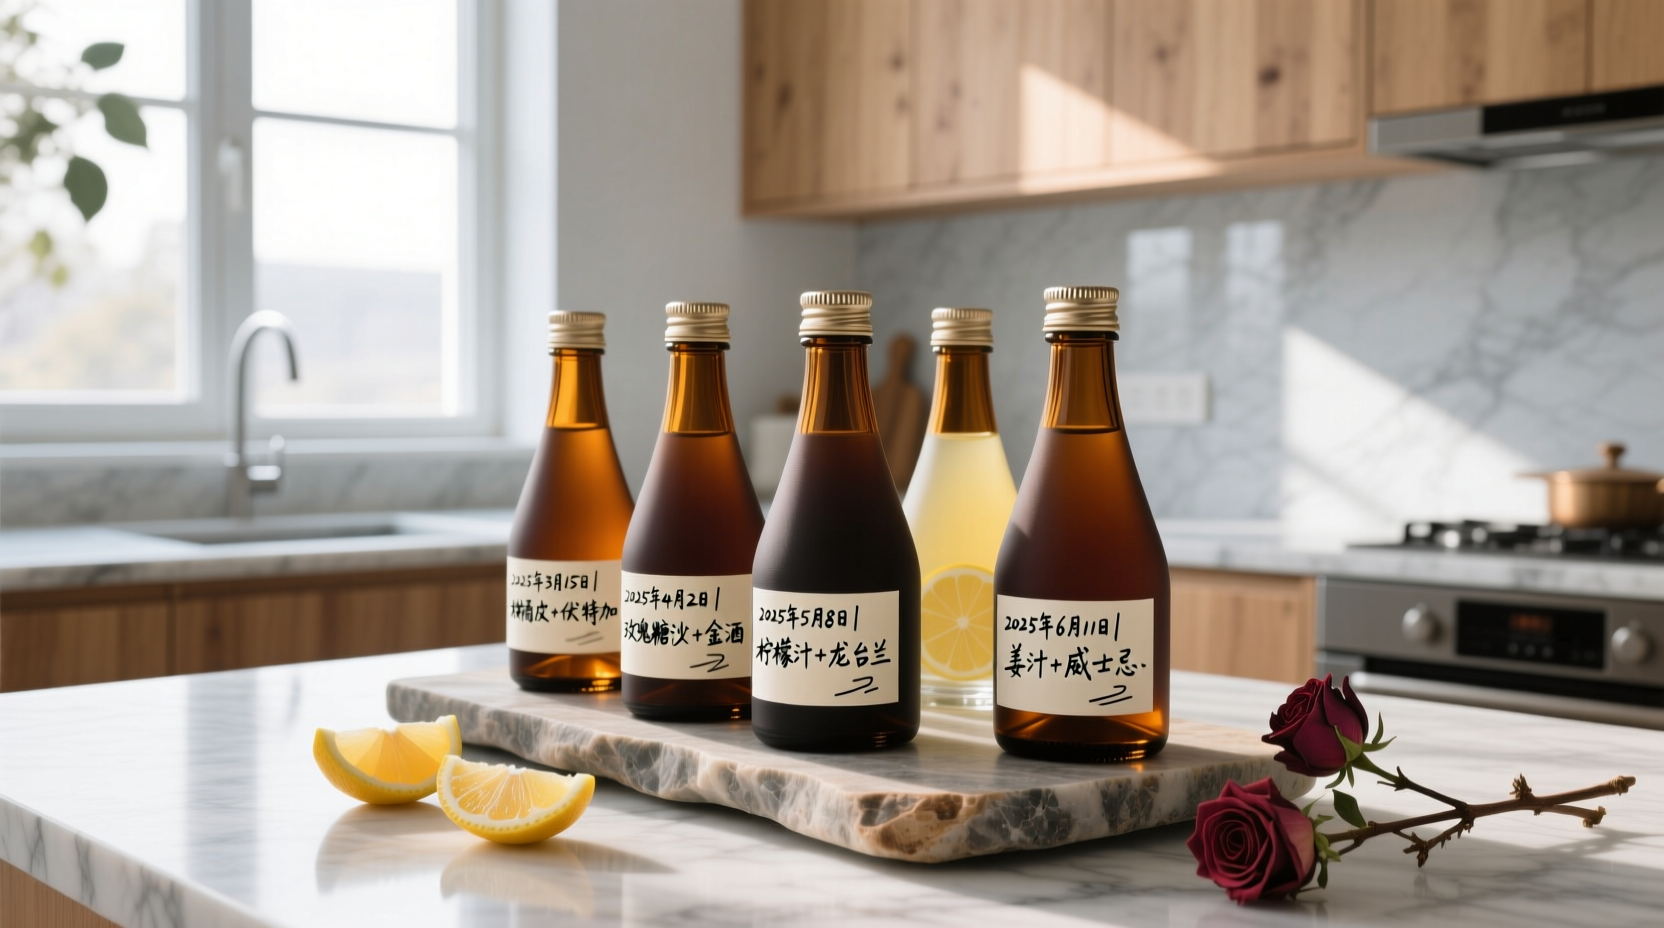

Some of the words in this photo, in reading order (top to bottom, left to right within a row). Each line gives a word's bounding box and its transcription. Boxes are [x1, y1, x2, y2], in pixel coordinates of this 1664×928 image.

[755, 637, 891, 669] 柠檬汁+龙台兰
